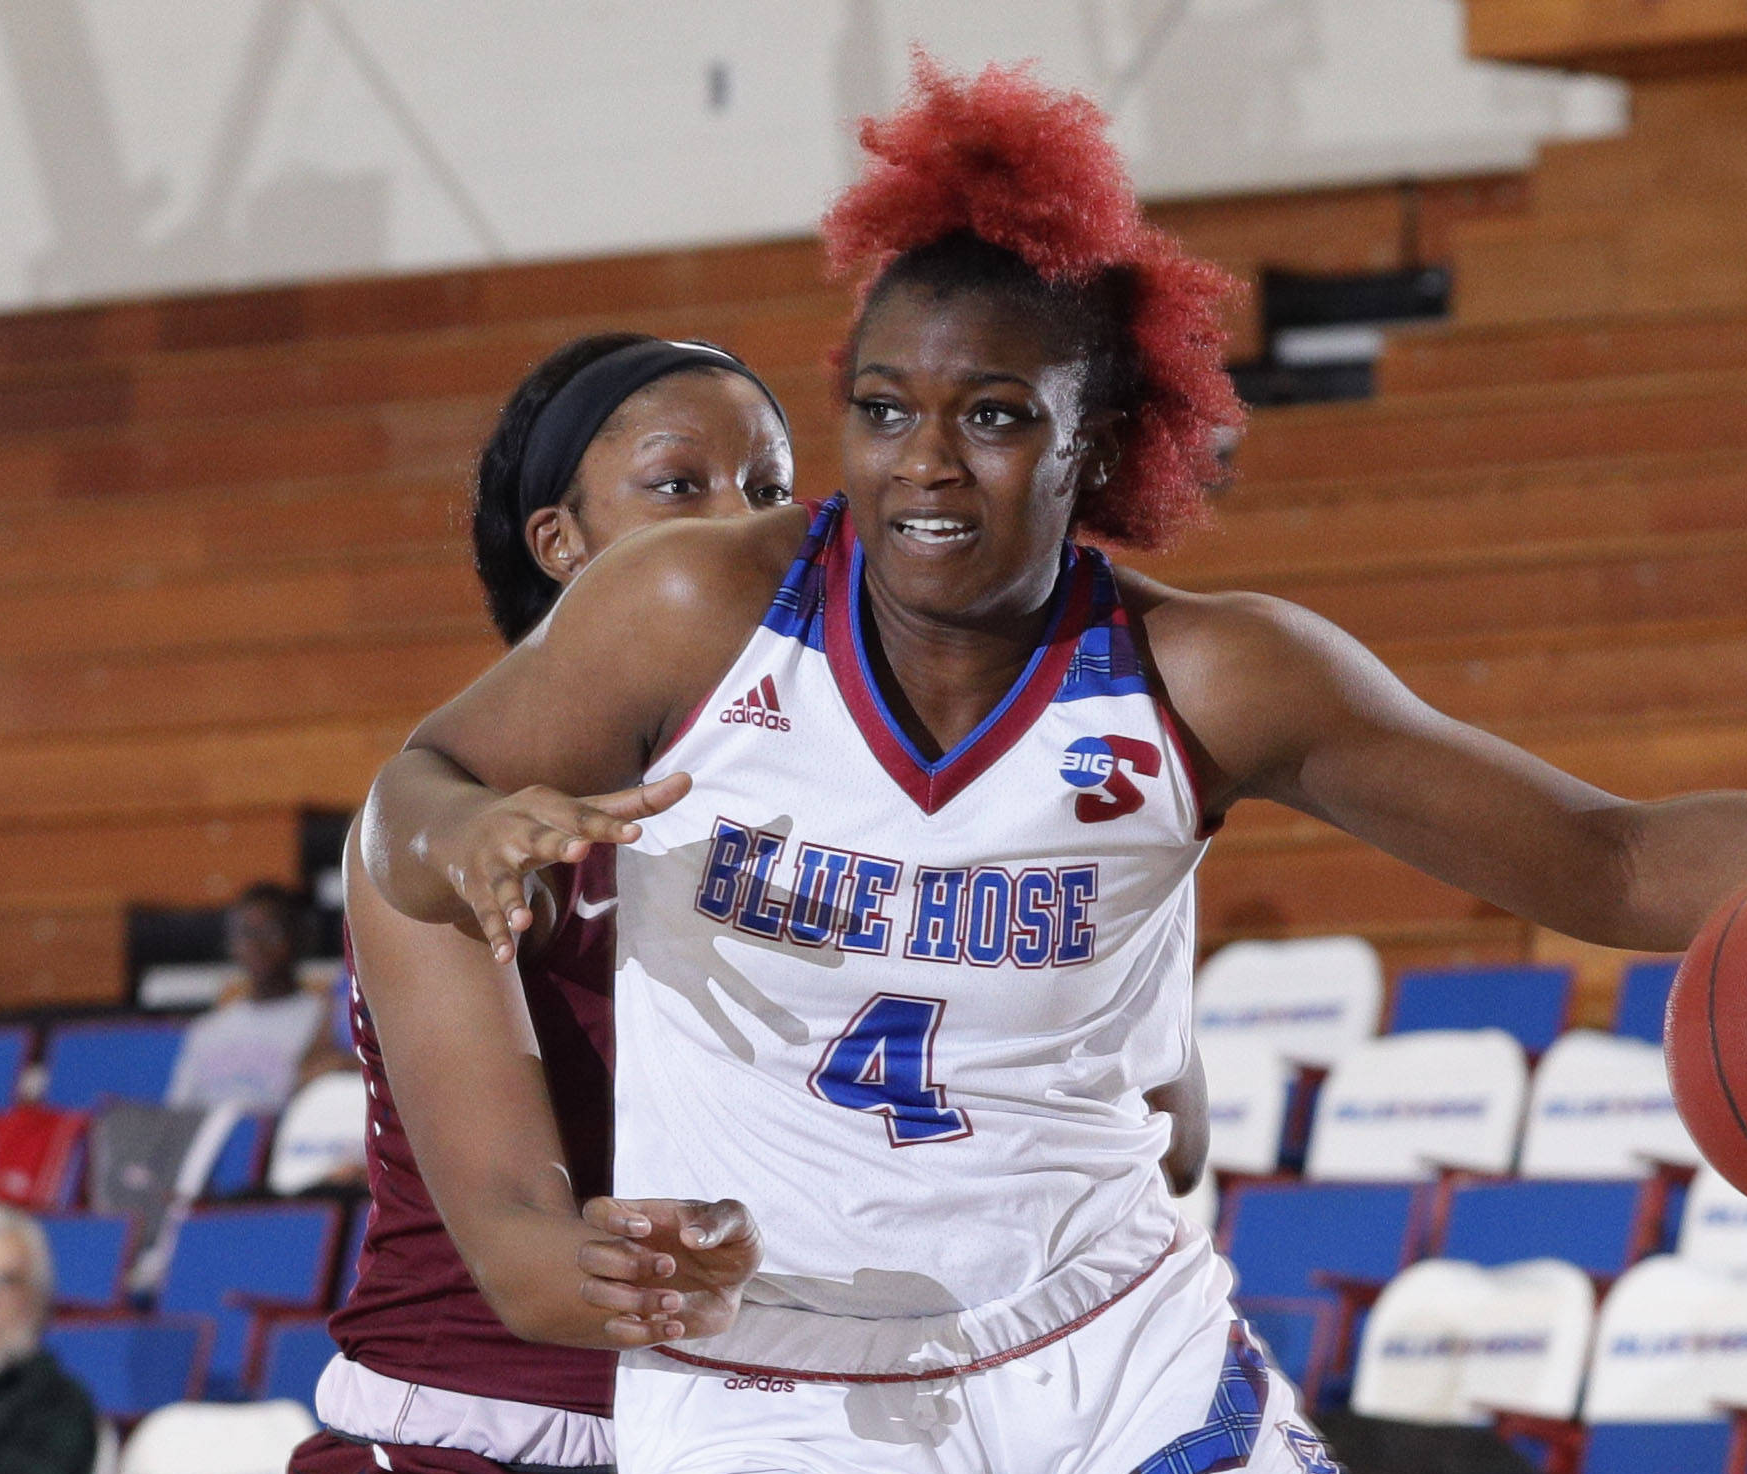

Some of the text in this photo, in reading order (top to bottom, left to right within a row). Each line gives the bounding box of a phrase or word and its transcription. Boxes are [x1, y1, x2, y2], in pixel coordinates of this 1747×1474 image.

[720, 704, 791, 732] adidas
[1061, 751, 1114, 776] BIG
[694, 815, 1099, 969] BLUE HOSE
[806, 991, 974, 1149] 4
[724, 1374, 796, 1393] adidas
